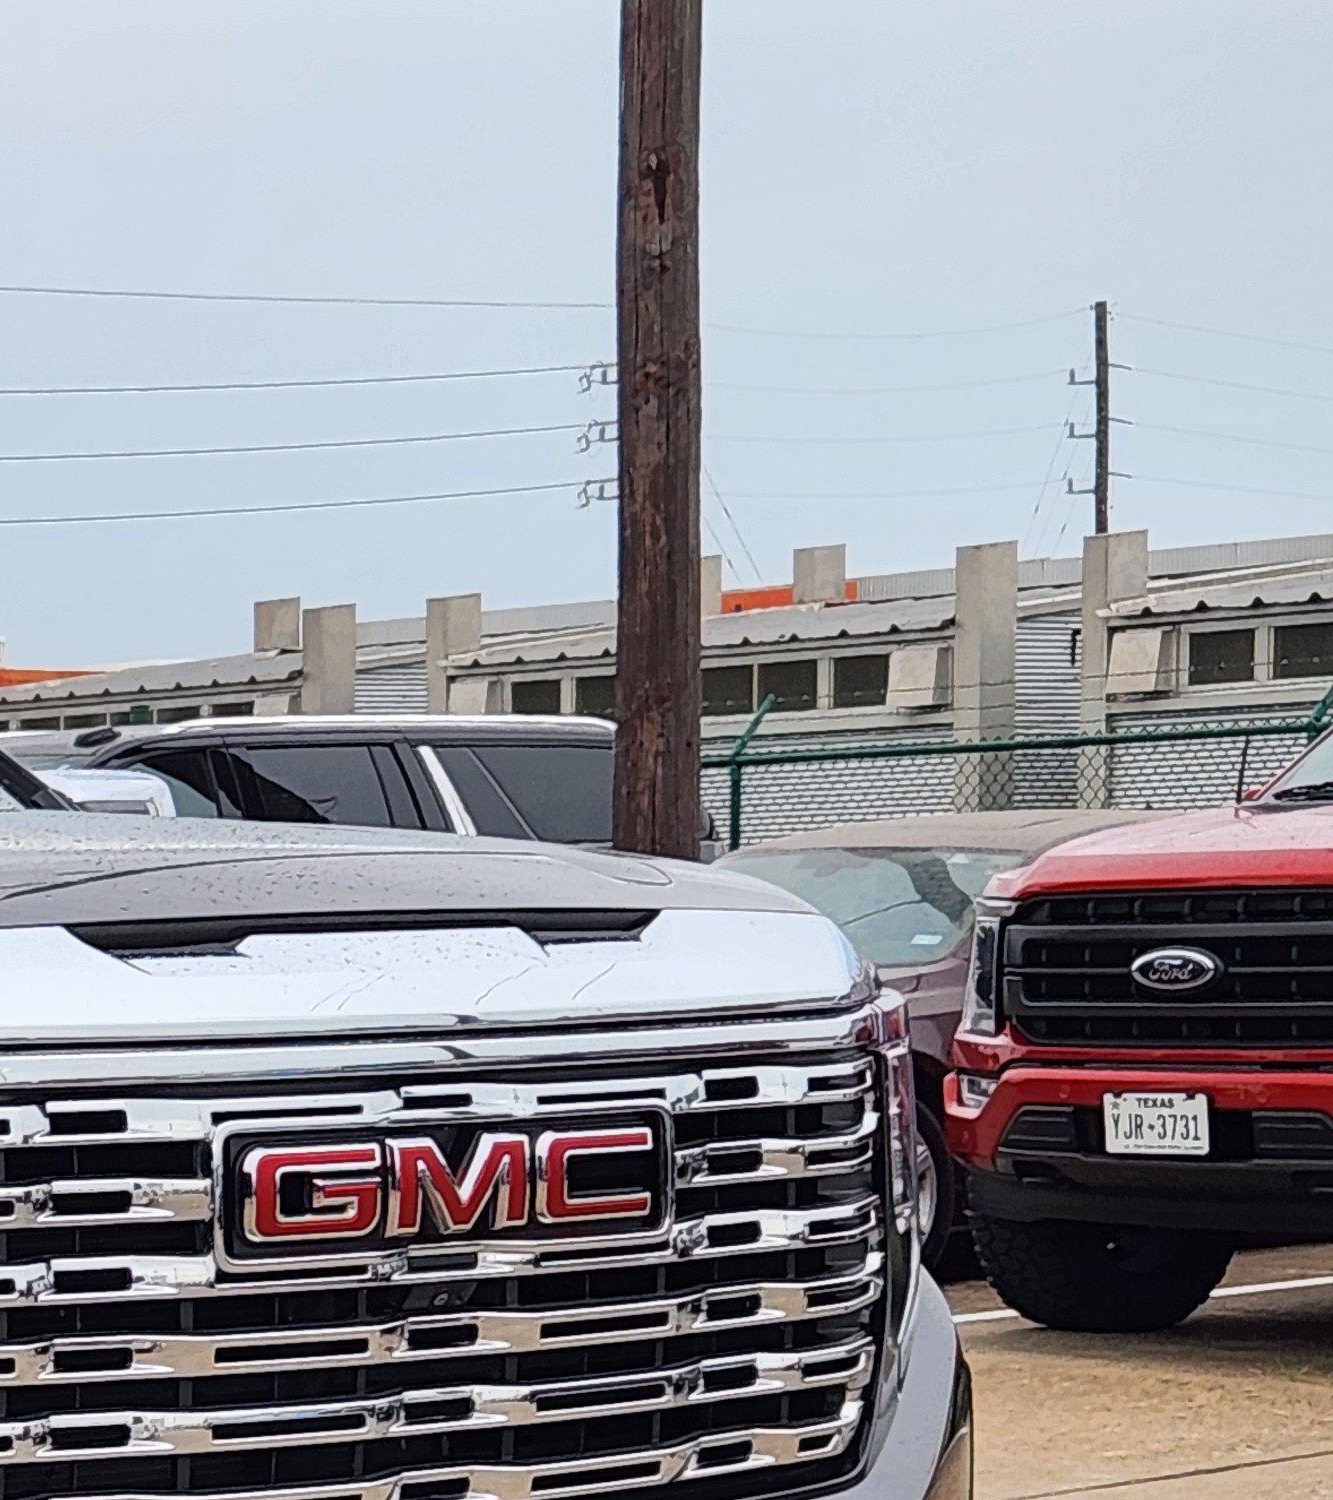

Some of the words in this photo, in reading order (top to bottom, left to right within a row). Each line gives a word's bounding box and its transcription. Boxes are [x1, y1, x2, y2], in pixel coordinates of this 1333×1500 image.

[1148, 959, 1194, 981] Ford
[1135, 1097, 1175, 1109] TEXAS
[1111, 1113, 1144, 1140] YJR
[1156, 1113, 1201, 1141] 3731
[243, 1126, 653, 1244] GMC
